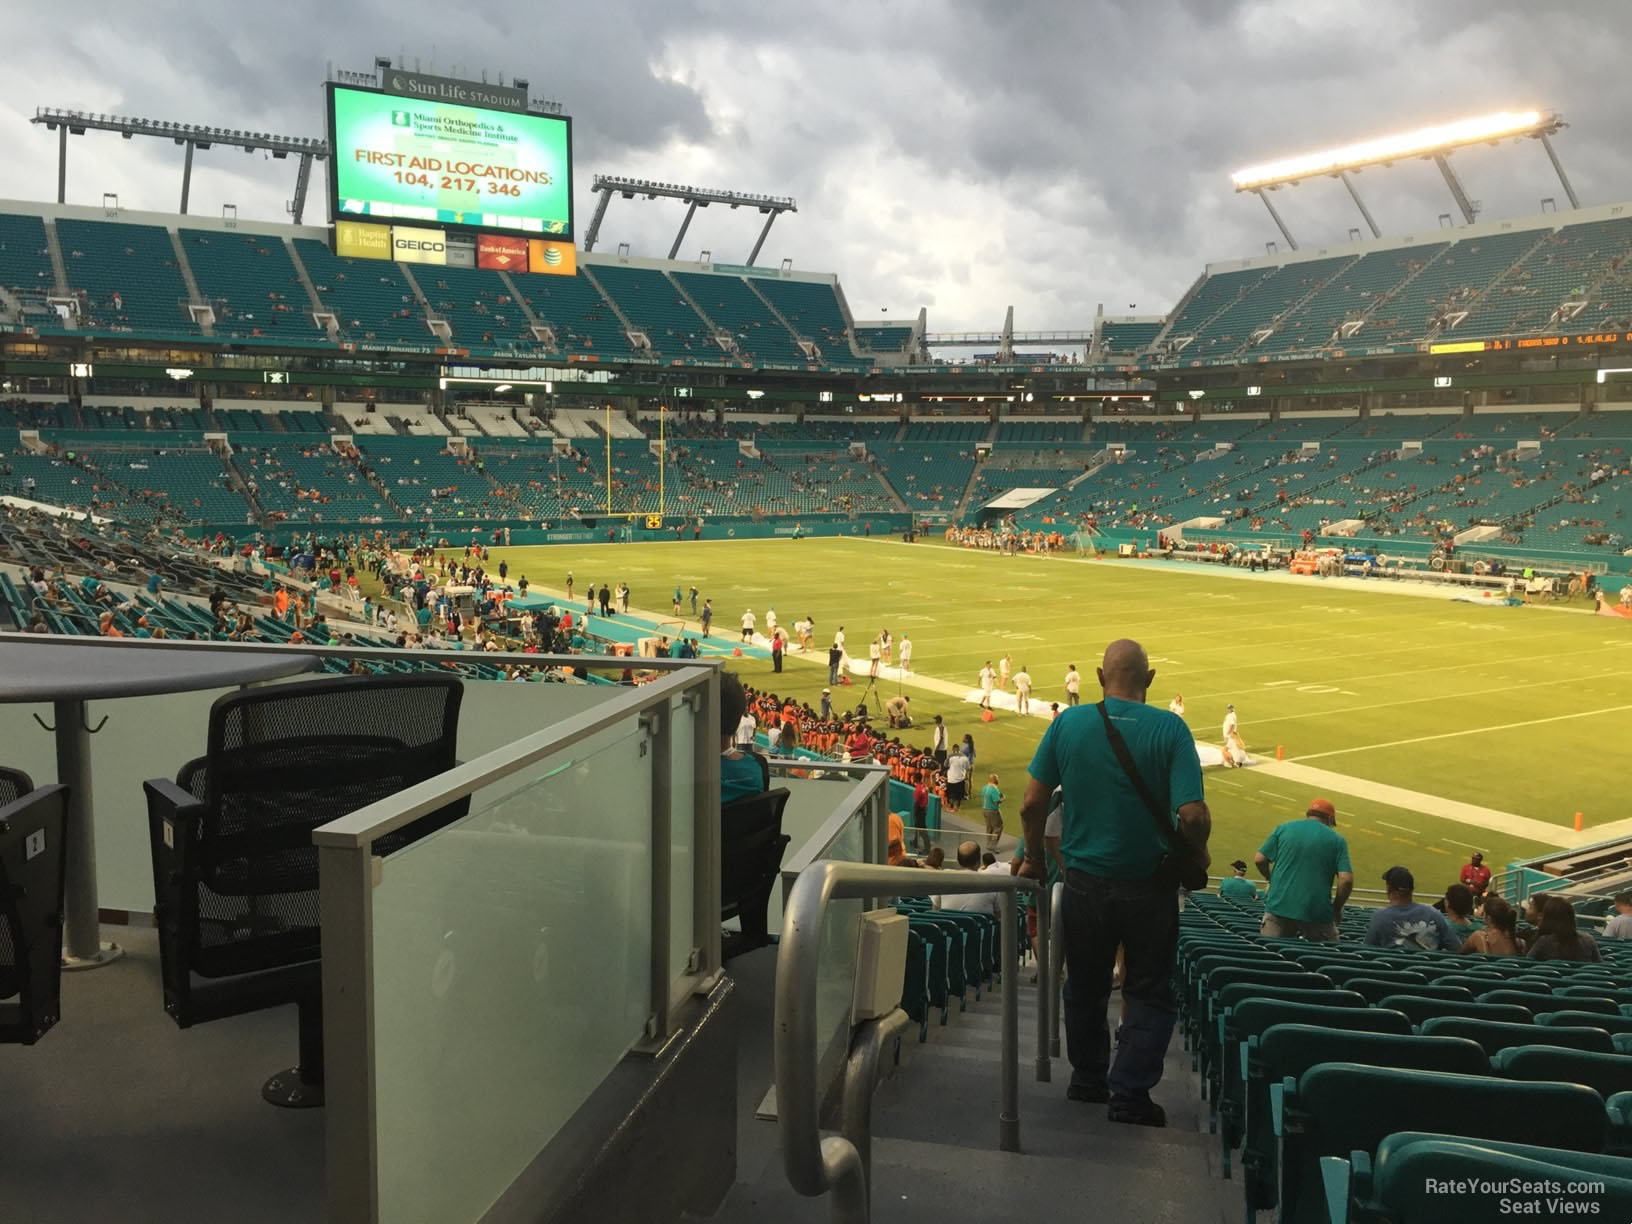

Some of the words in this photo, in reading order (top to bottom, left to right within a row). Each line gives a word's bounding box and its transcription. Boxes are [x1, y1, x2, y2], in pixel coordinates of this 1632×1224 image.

[408, 79, 437, 96] Sun
[440, 83, 467, 100] Life
[470, 91, 521, 107] STADIUM
[413, 112, 442, 124] Miami
[443, 117, 495, 132] Orthopedics
[496, 124, 504, 132] &
[413, 121, 442, 132] Sports
[444, 124, 482, 137] Medicine
[484, 130, 519, 142] Institute
[355, 149, 406, 167] FIRST
[408, 156, 442, 171] AID
[446, 159, 553, 185] LOCATIONS:
[394, 171, 434, 189] 104,
[440, 176, 481, 194] 217,
[487, 182, 521, 197] 346
[358, 238, 388, 249] Health
[395, 239, 445, 252] GEICO
[479, 245, 492, 253] Bank
[501, 247, 527, 256] America
[647, 515, 660, 528] 25
